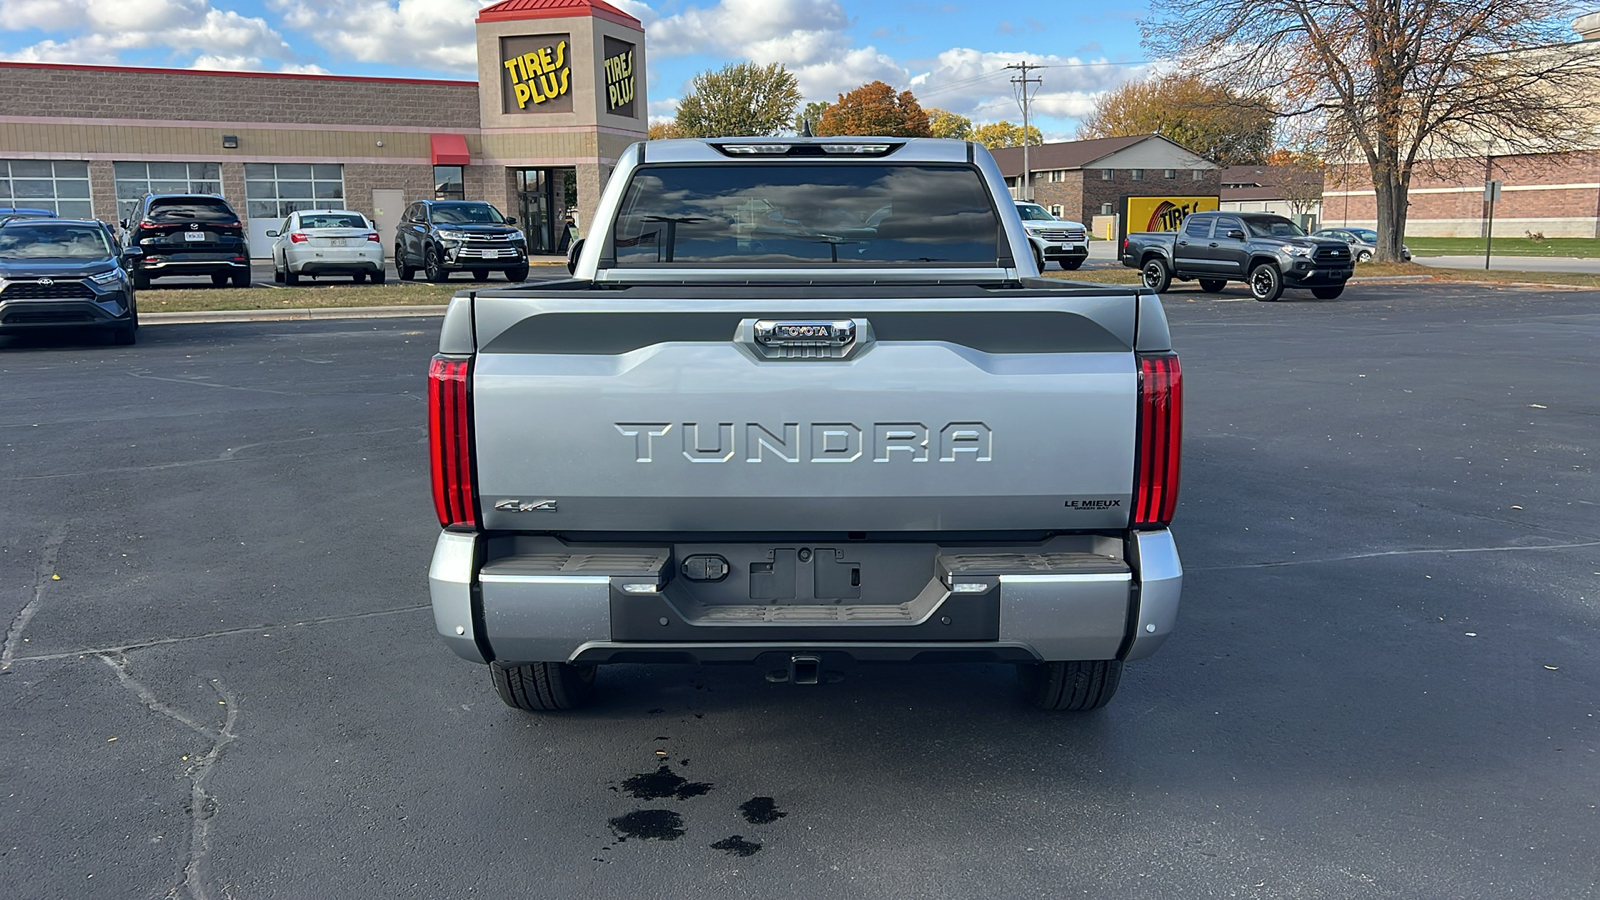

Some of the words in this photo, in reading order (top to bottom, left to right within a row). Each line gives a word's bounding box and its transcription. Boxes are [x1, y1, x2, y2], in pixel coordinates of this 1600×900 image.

[504, 40, 566, 84] TIRES
[604, 50, 633, 84] TIRES
[513, 67, 570, 109] PLUS
[608, 76, 635, 110] PLUS
[782, 326, 829, 337] TOYOTA
[614, 422, 992, 462] TUNDRA
[1064, 500, 1079, 508] LE
[1081, 499, 1121, 507] MIEUX
